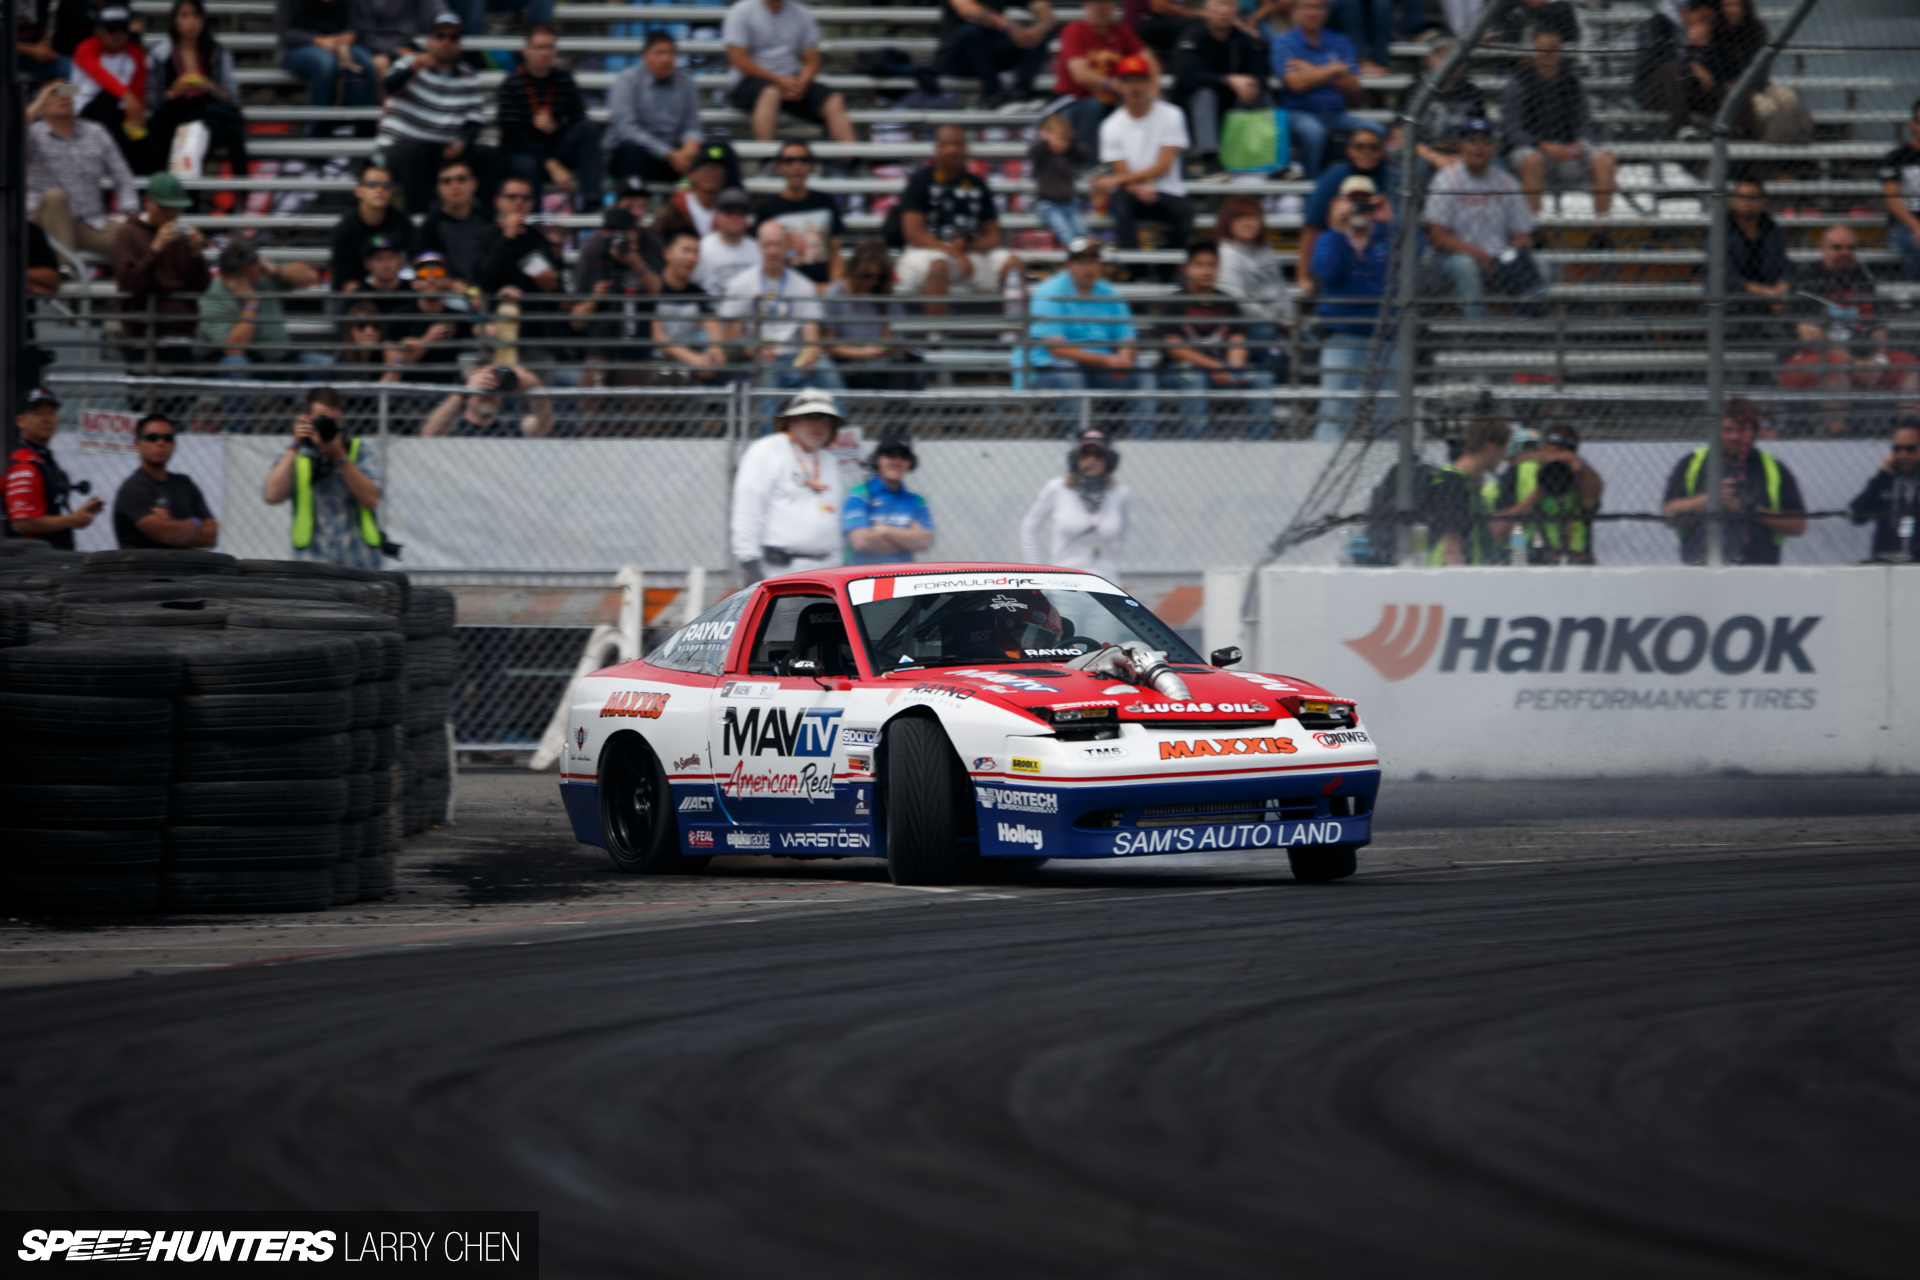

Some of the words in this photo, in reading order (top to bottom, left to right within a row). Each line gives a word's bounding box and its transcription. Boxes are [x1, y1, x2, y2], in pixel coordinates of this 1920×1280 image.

[682, 621, 736, 641] RAYNO
[909, 683, 977, 700] RAYNO
[1514, 689, 1726, 710] PERFORMANCE
[1738, 689, 1817, 709] TIRES
[600, 692, 671, 719] MAXXIS
[1142, 703, 1214, 713] LUCAS
[1218, 703, 1256, 713] OIL
[723, 707, 844, 757] MAVTV
[1323, 732, 1370, 745] CROWER
[1159, 737, 1298, 760] MAXXIS
[721, 760, 797, 800] American
[995, 789, 1058, 808] VORTECH
[696, 830, 714, 841] FEAL
[998, 823, 1042, 850] Holley
[1113, 828, 1194, 855] SAM'S
[1198, 824, 1271, 849] AUTO
[1277, 822, 1342, 845] LAND
